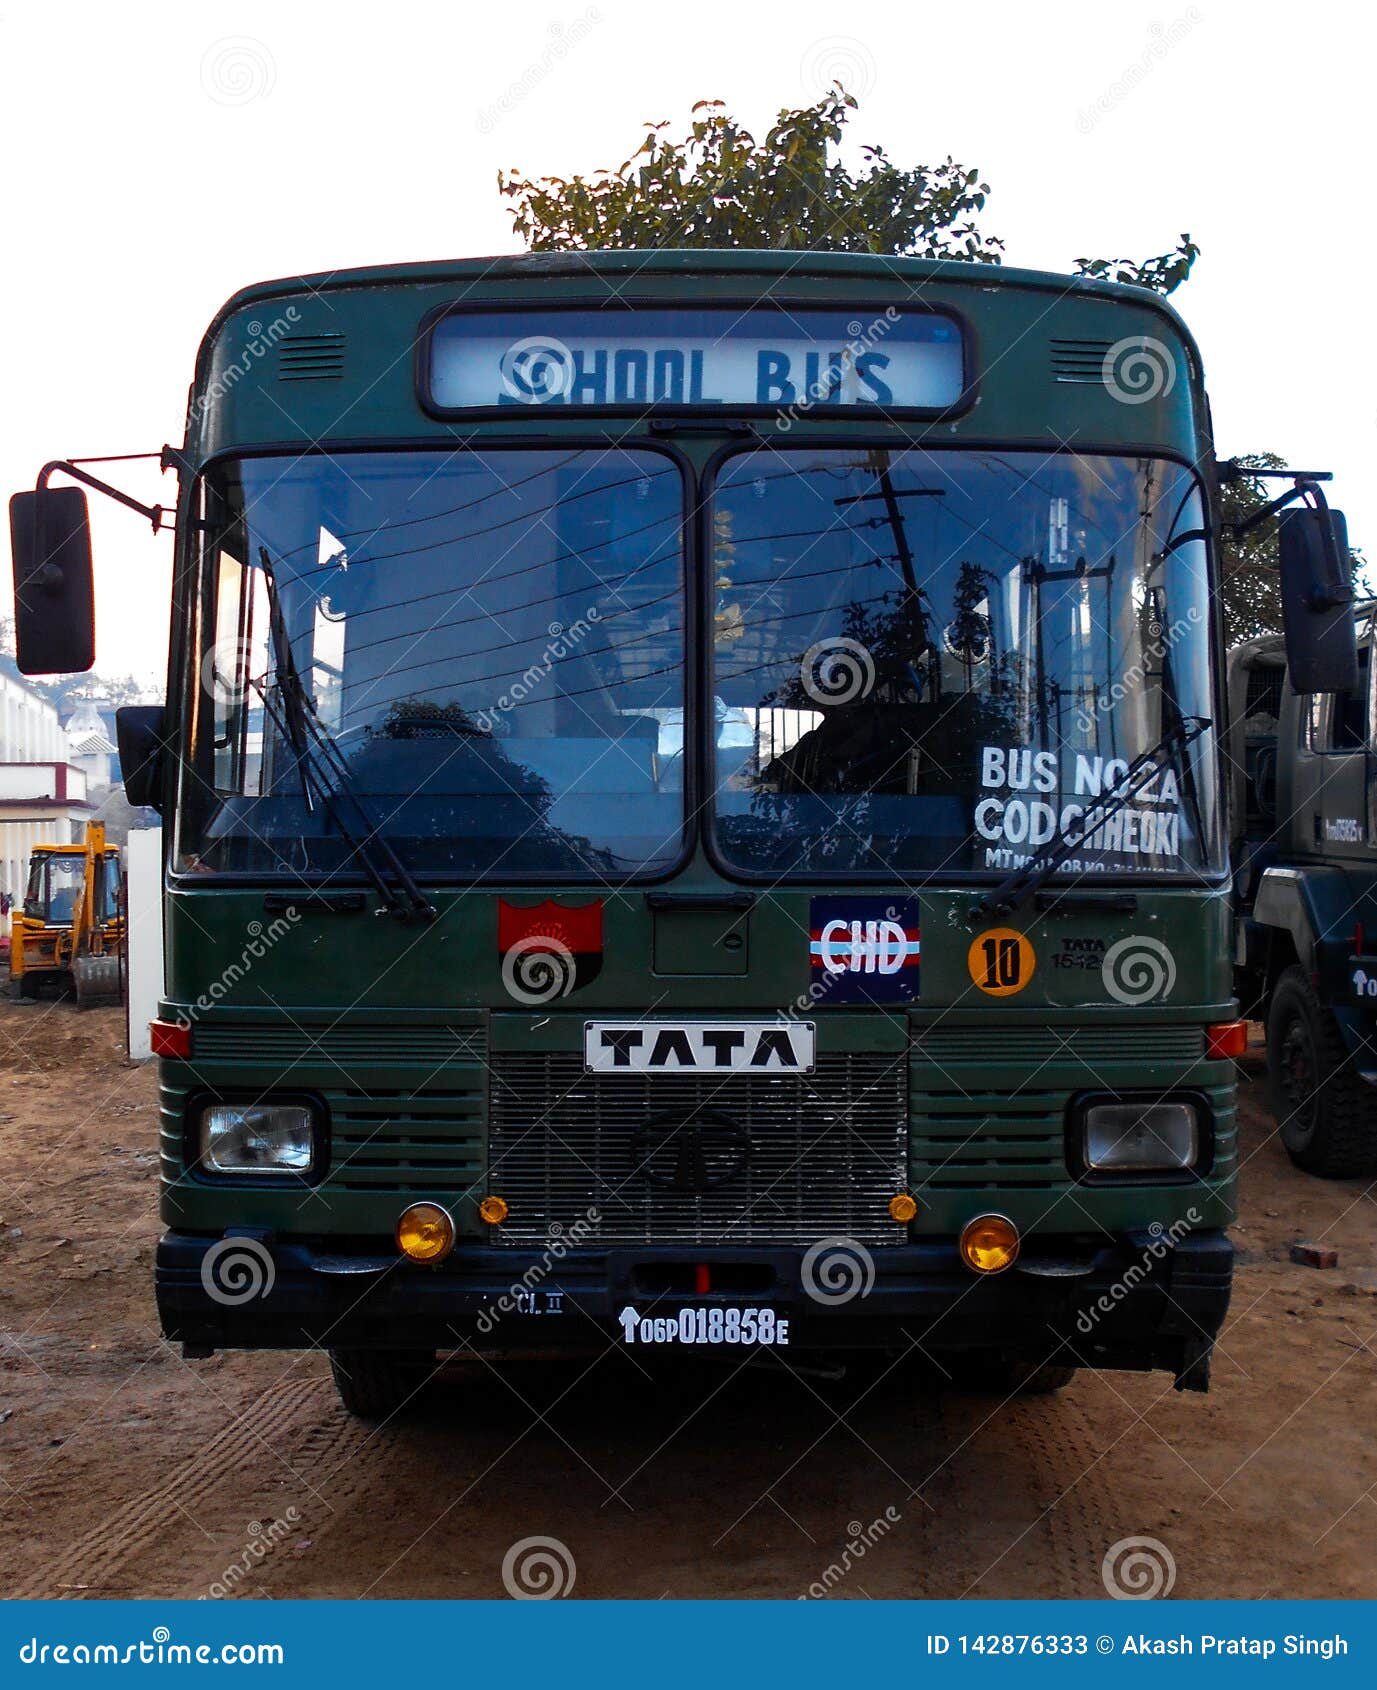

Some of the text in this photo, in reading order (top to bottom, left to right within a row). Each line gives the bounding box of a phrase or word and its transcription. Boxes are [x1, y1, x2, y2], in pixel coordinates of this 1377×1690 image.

[498, 348, 893, 405] SCHOOL BUS
[982, 747, 1058, 792] BUS
[820, 919, 908, 974] CHD
[982, 938, 1020, 988] 10
[1061, 938, 1105, 951] TATA
[600, 1029, 799, 1066] TATA
